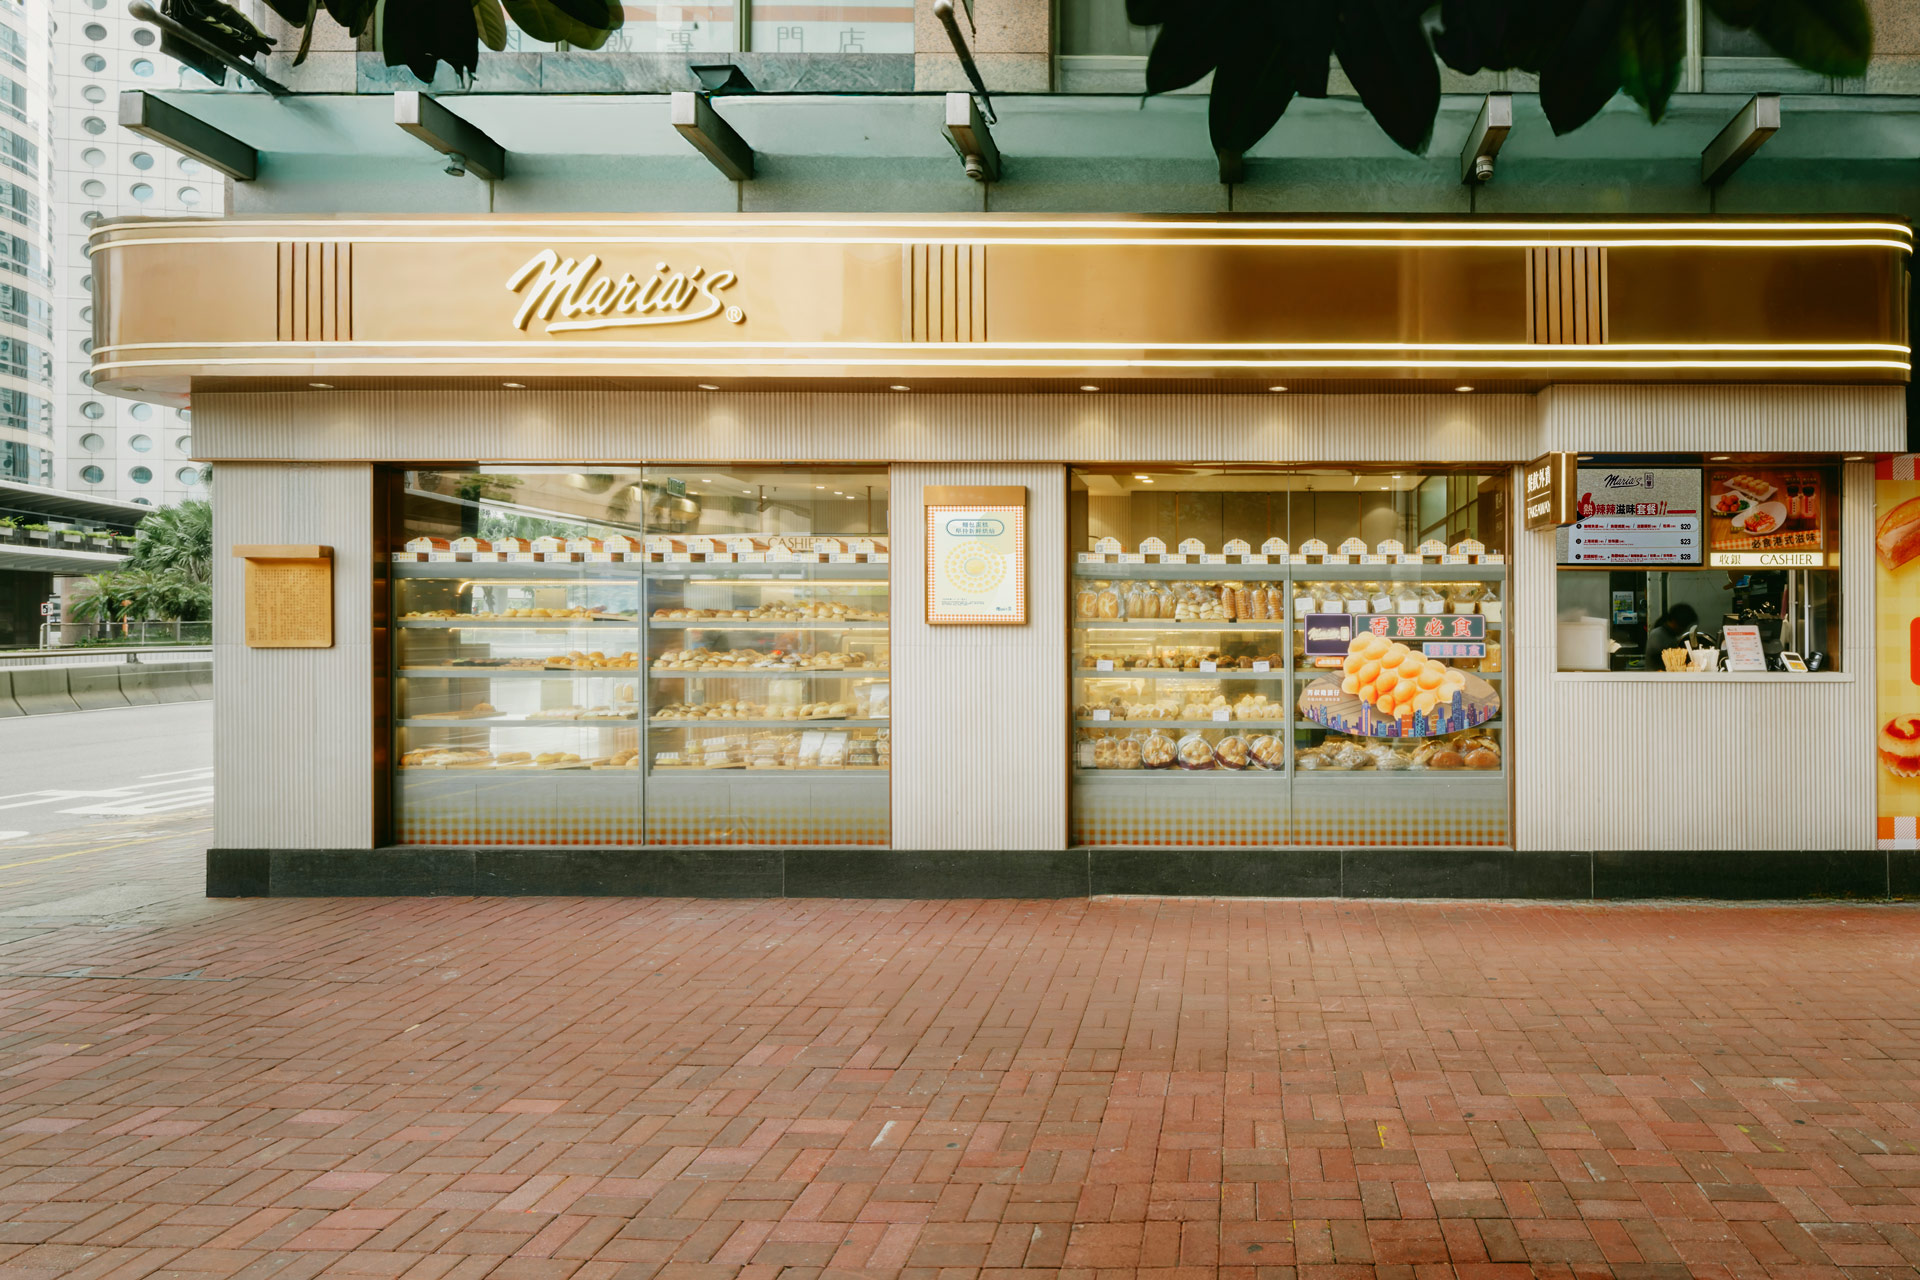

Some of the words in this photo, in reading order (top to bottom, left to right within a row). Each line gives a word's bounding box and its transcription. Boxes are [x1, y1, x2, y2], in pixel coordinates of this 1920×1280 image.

[505, 248, 735, 333] Maria's
[1604, 473, 1642, 489] Maria's
[1751, 533, 1816, 549] 必食港式滋味
[1719, 554, 1740, 565] 收銀
[1760, 554, 1813, 565] CASHIER
[1369, 617, 1471, 637] 香港必食
